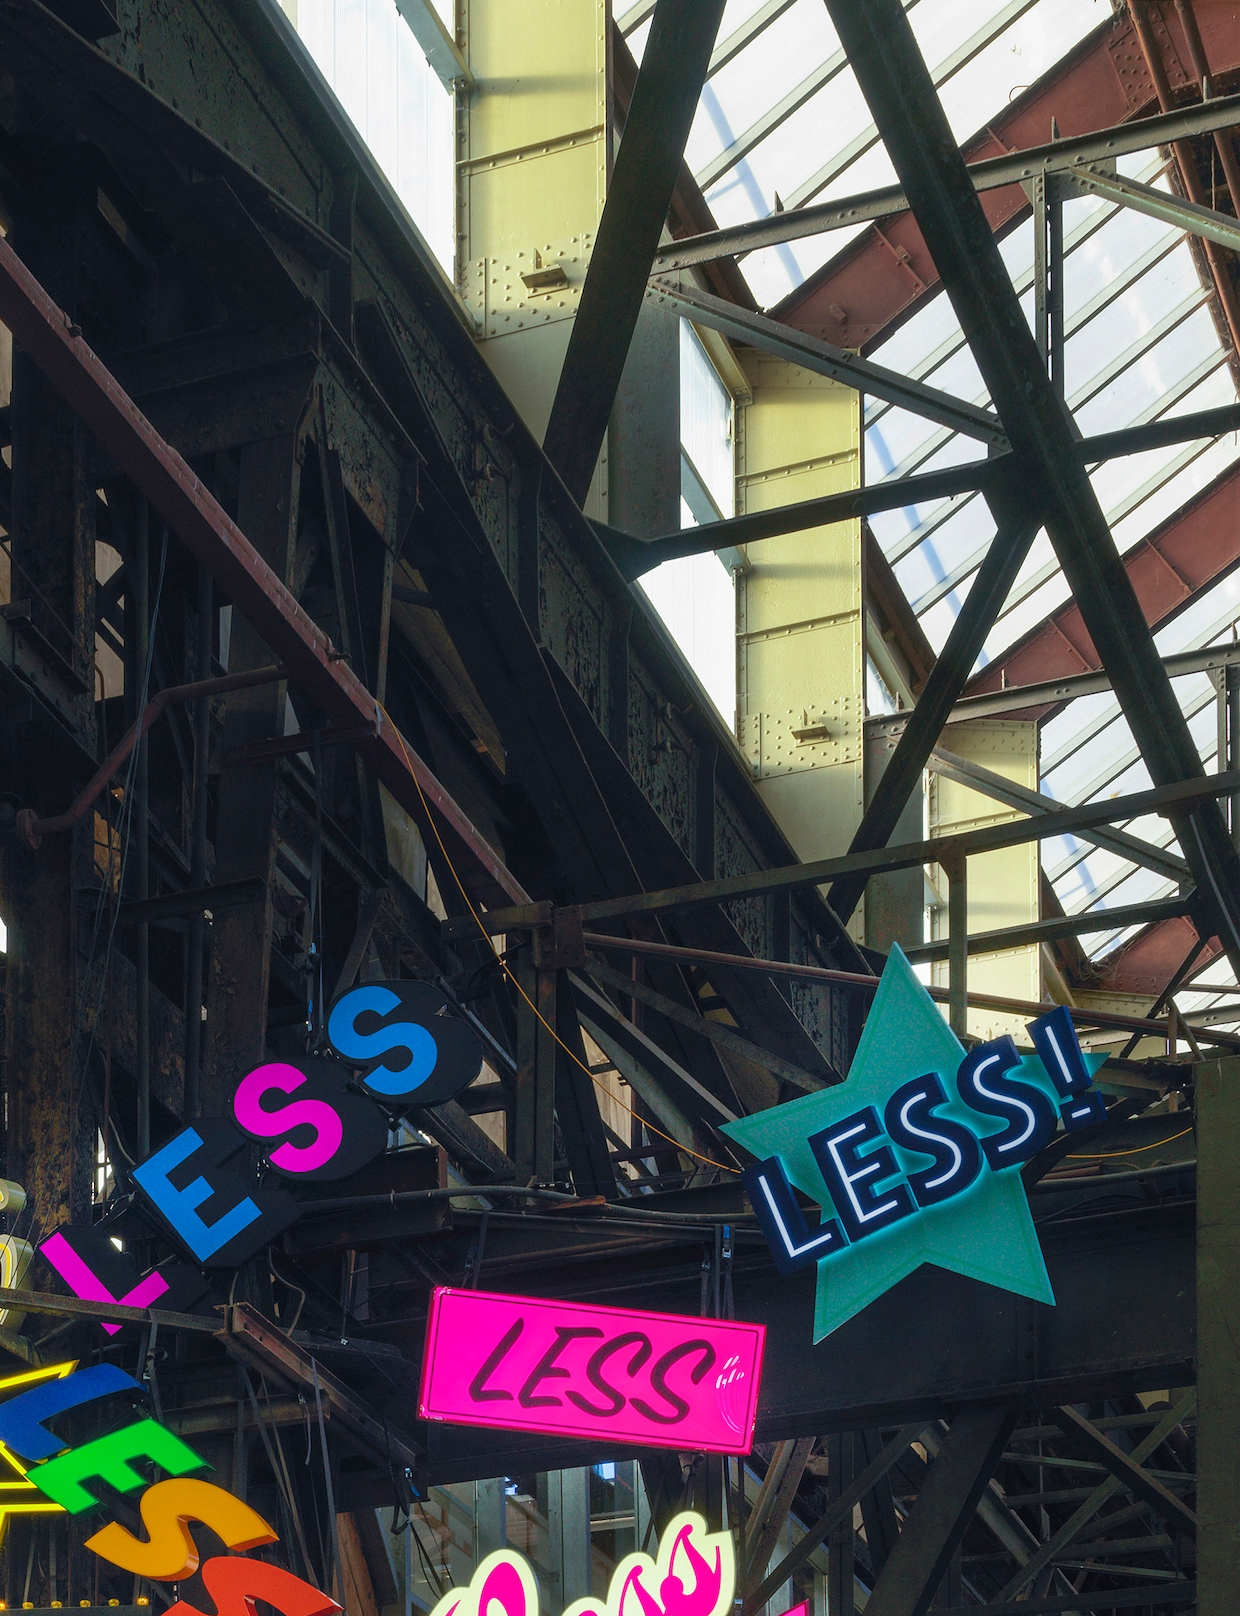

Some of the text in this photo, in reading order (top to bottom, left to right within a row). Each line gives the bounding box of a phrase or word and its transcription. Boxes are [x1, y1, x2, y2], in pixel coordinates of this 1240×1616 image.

[39, 984, 439, 1336] LESS
[740, 1004, 1108, 1276] LESS!
[468, 1316, 717, 1425] LESS
